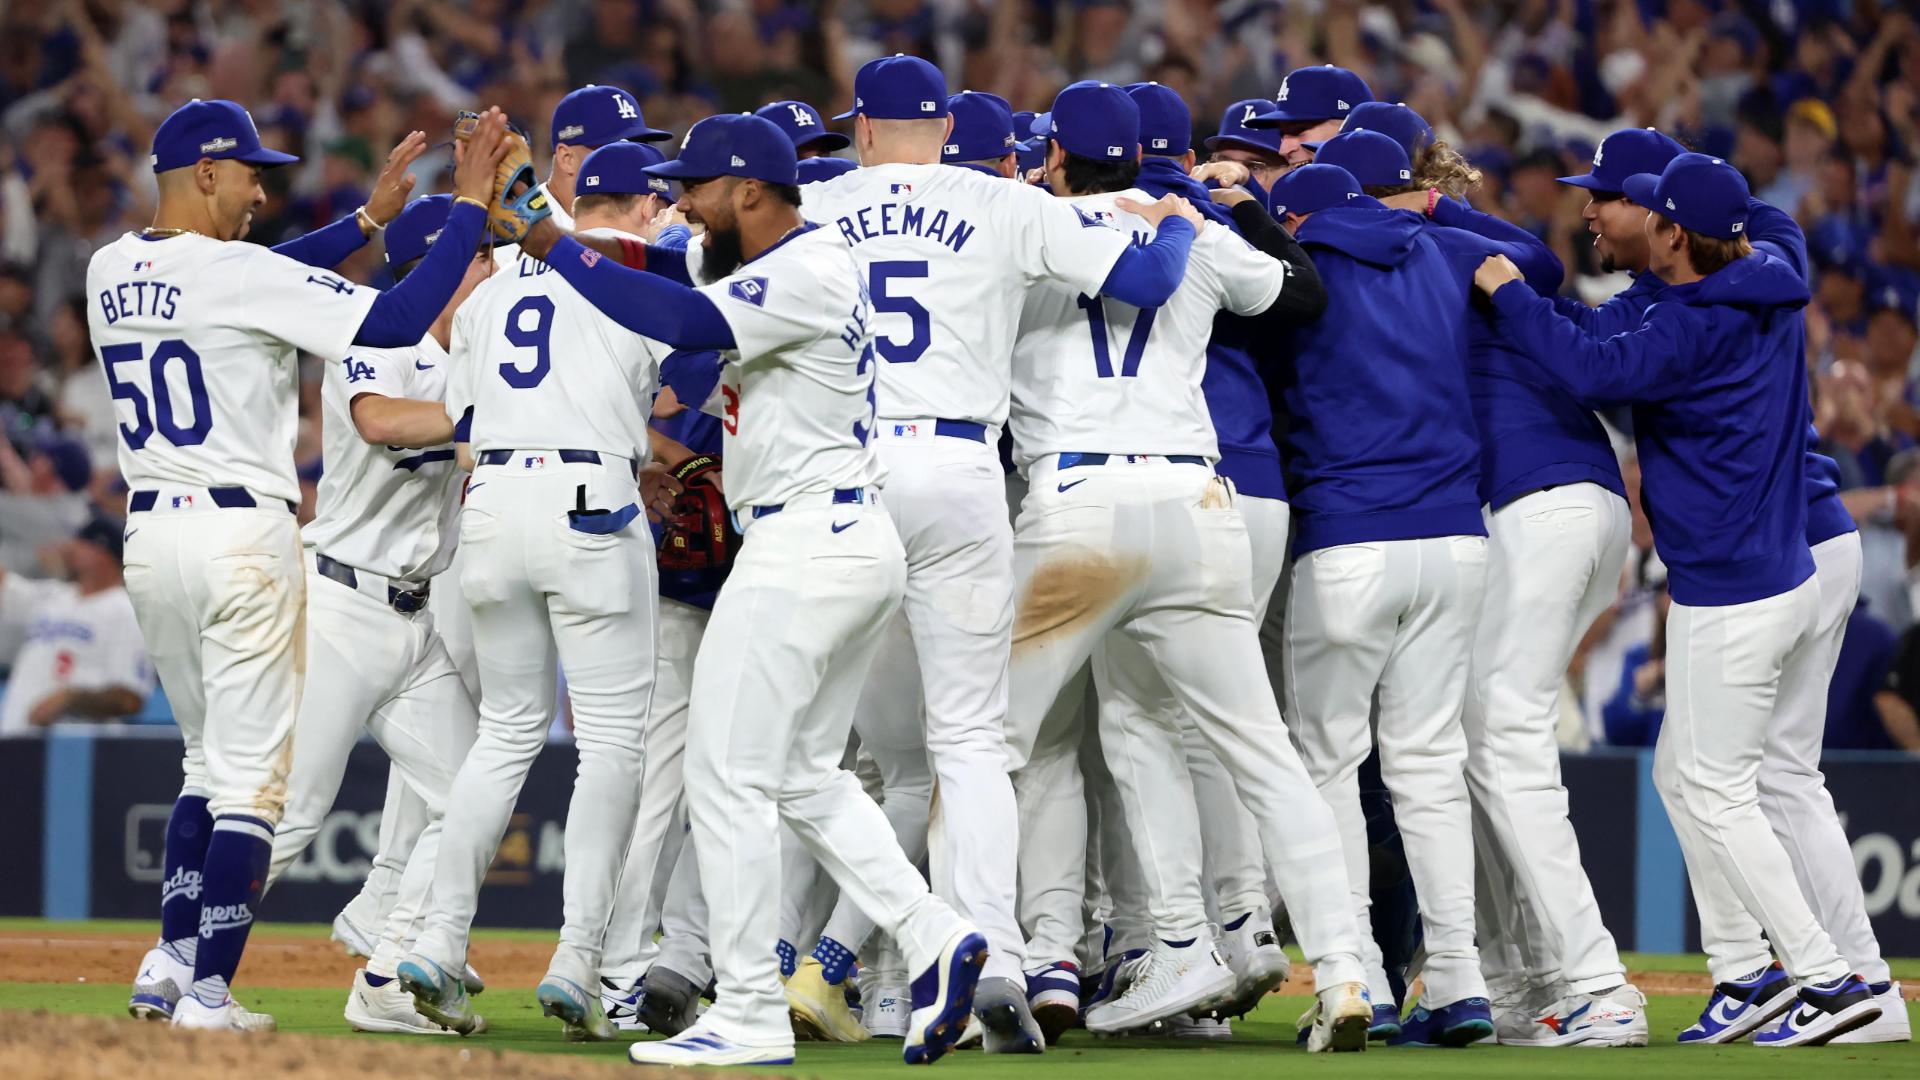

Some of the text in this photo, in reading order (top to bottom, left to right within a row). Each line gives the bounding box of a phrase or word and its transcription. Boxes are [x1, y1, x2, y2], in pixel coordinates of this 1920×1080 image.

[612, 94, 637, 118] LA
[787, 104, 815, 126] LA
[836, 203, 975, 253] REEMAN
[100, 281, 181, 325] BETTS
[869, 260, 931, 363] 5
[499, 295, 555, 388] 9
[1077, 291, 1158, 378] 17
[100, 340, 212, 450] 50
[338, 356, 376, 389] LA
[722, 384, 741, 436] 3
